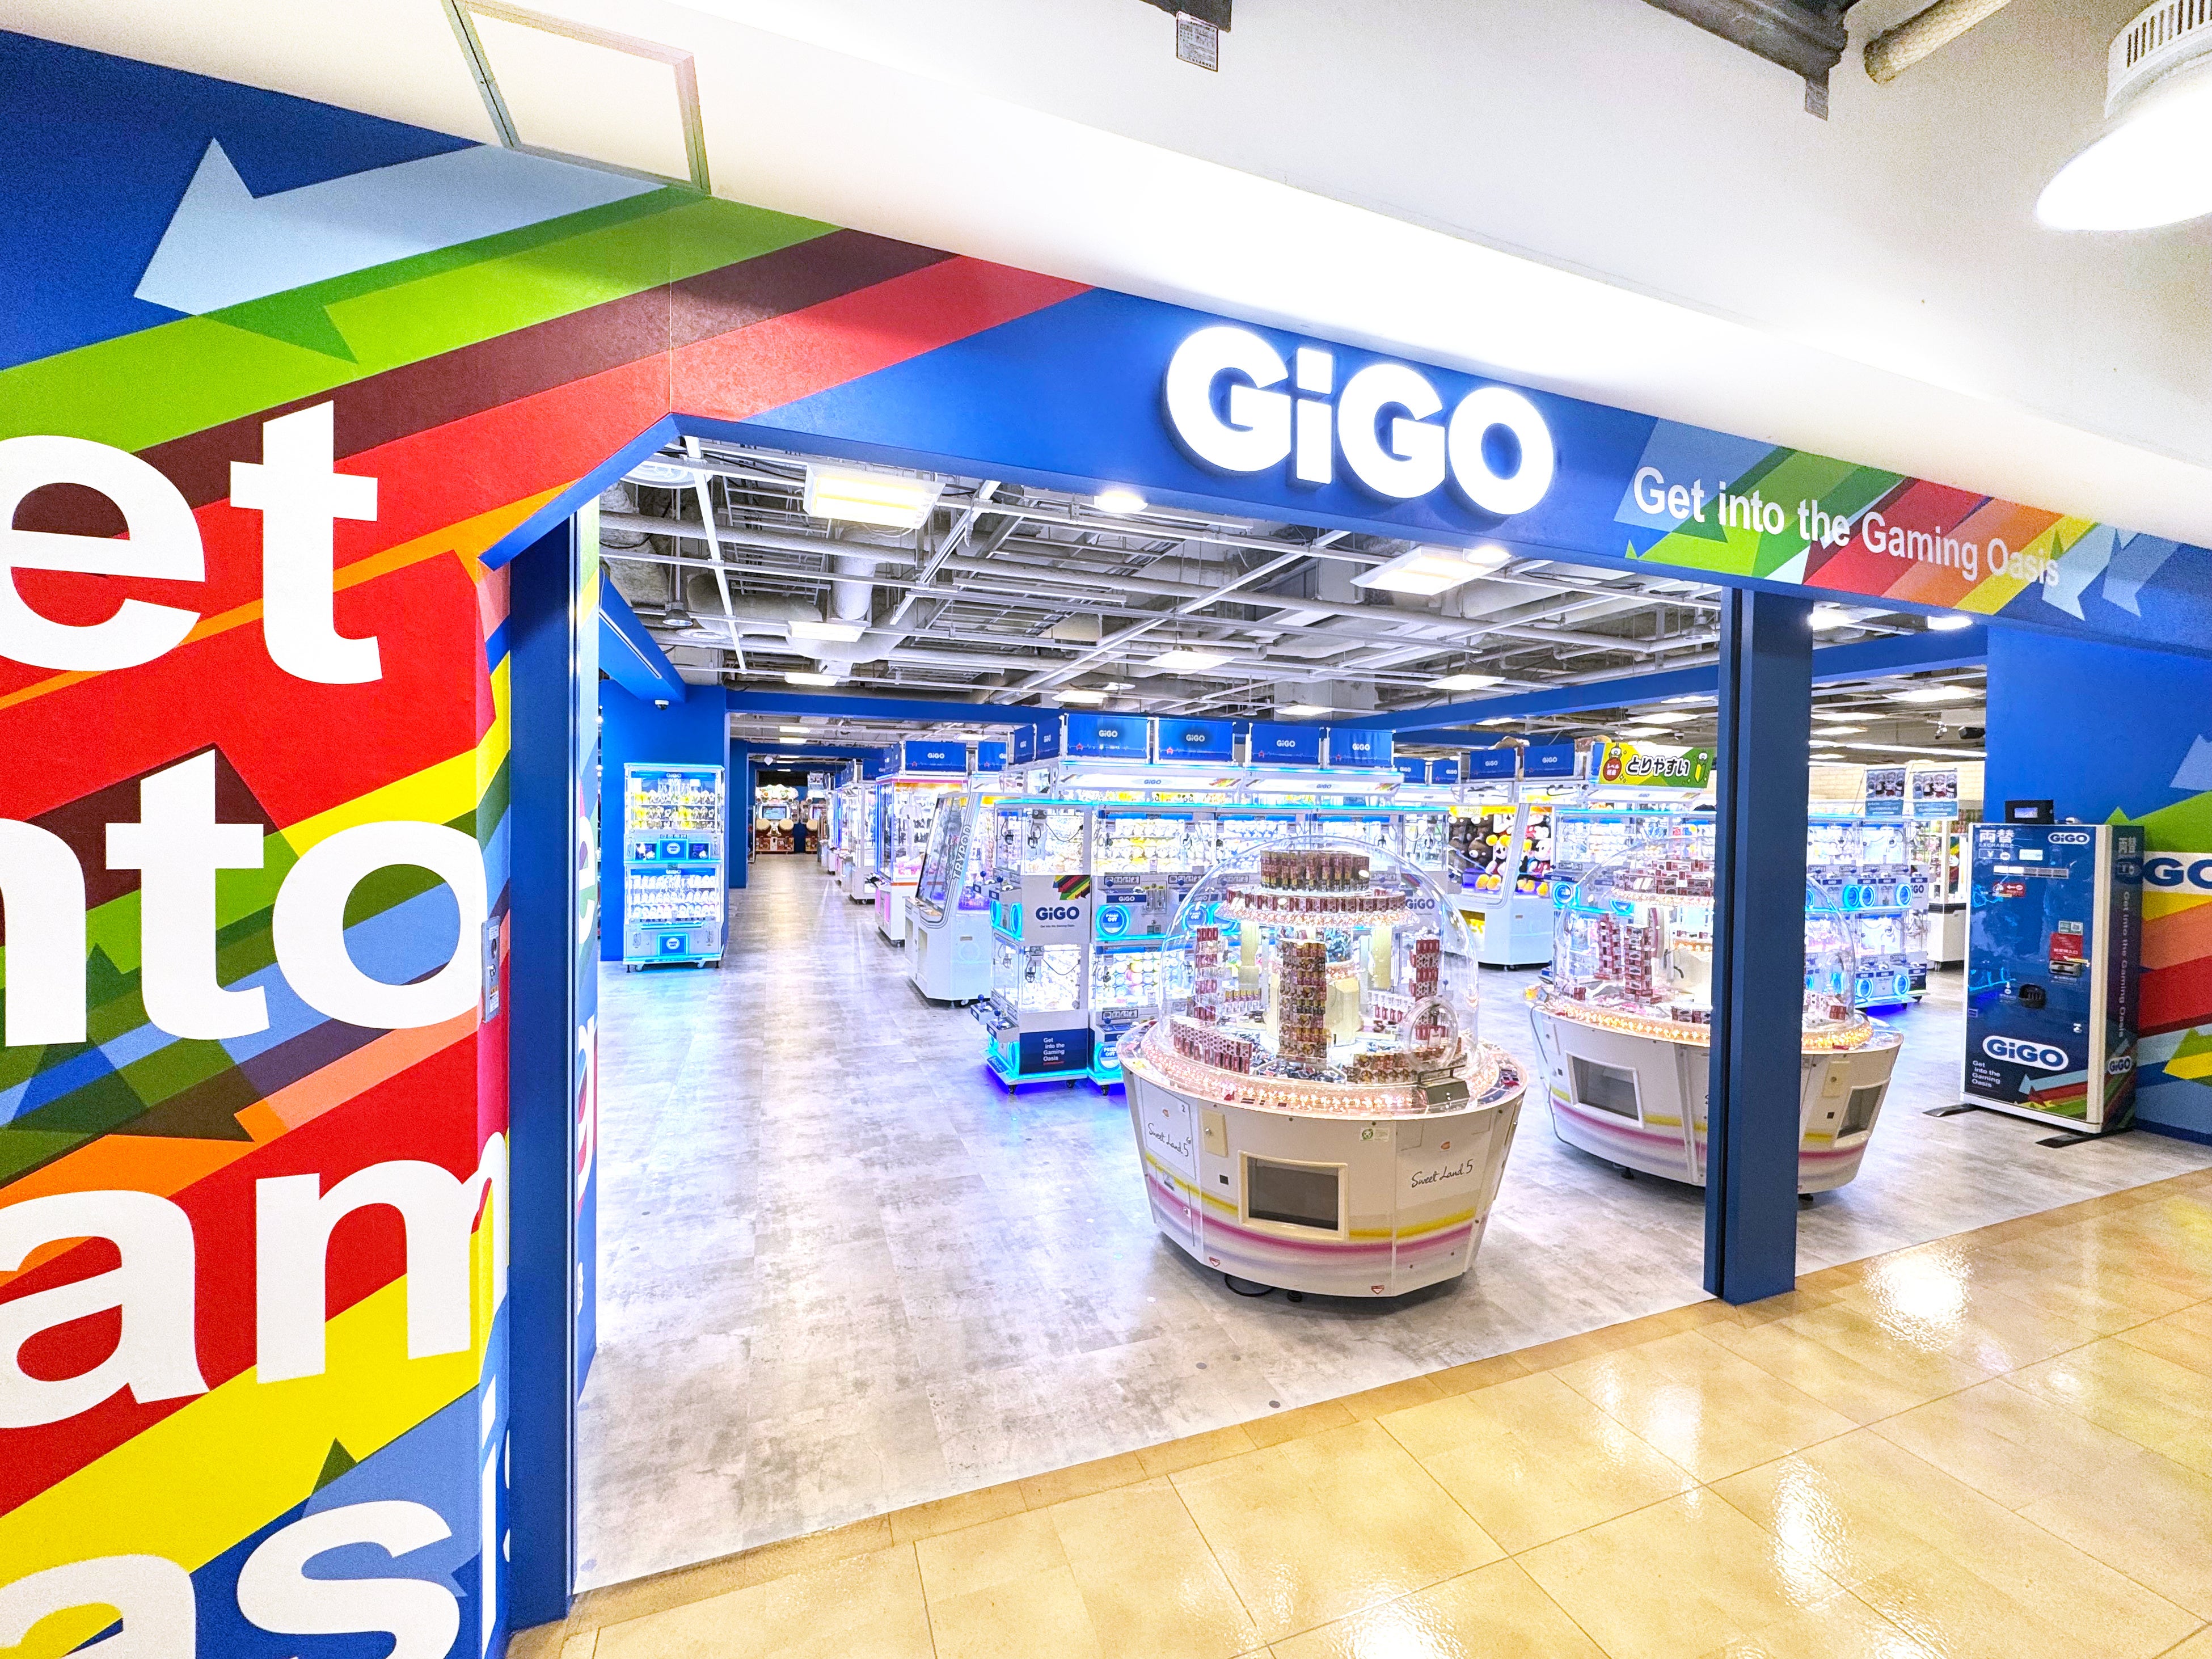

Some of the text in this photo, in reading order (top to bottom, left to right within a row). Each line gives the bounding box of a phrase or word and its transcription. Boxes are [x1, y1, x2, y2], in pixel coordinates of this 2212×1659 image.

[1166, 326, 1554, 515] GiGO
[1633, 466, 2060, 588] Get into the Gaming Oasis
[0, 400, 383, 685] et
[1626, 755, 1690, 776] とりやすい
[1979, 829, 2015, 843] 両替
[2049, 833, 2088, 843] GiGO
[953, 825, 972, 880] TRYPOD
[2142, 858, 2212, 889] GO
[1036, 906, 1080, 921] GiGO
[1405, 898, 1435, 910] GiGO
[2119, 959, 2128, 1003] Gaming
[1986, 1039, 2065, 1067] GiGO
[2108, 1057, 2131, 1072] GiGO
[1972, 1073, 2001, 1084] Gaming
[1972, 1078, 1993, 1088] Oasis
[1181, 1104, 1186, 1113] 2
[1147, 1122, 1189, 1158] Sweet Land 5
[1411, 1158, 1474, 1188] Sweet Land 5
